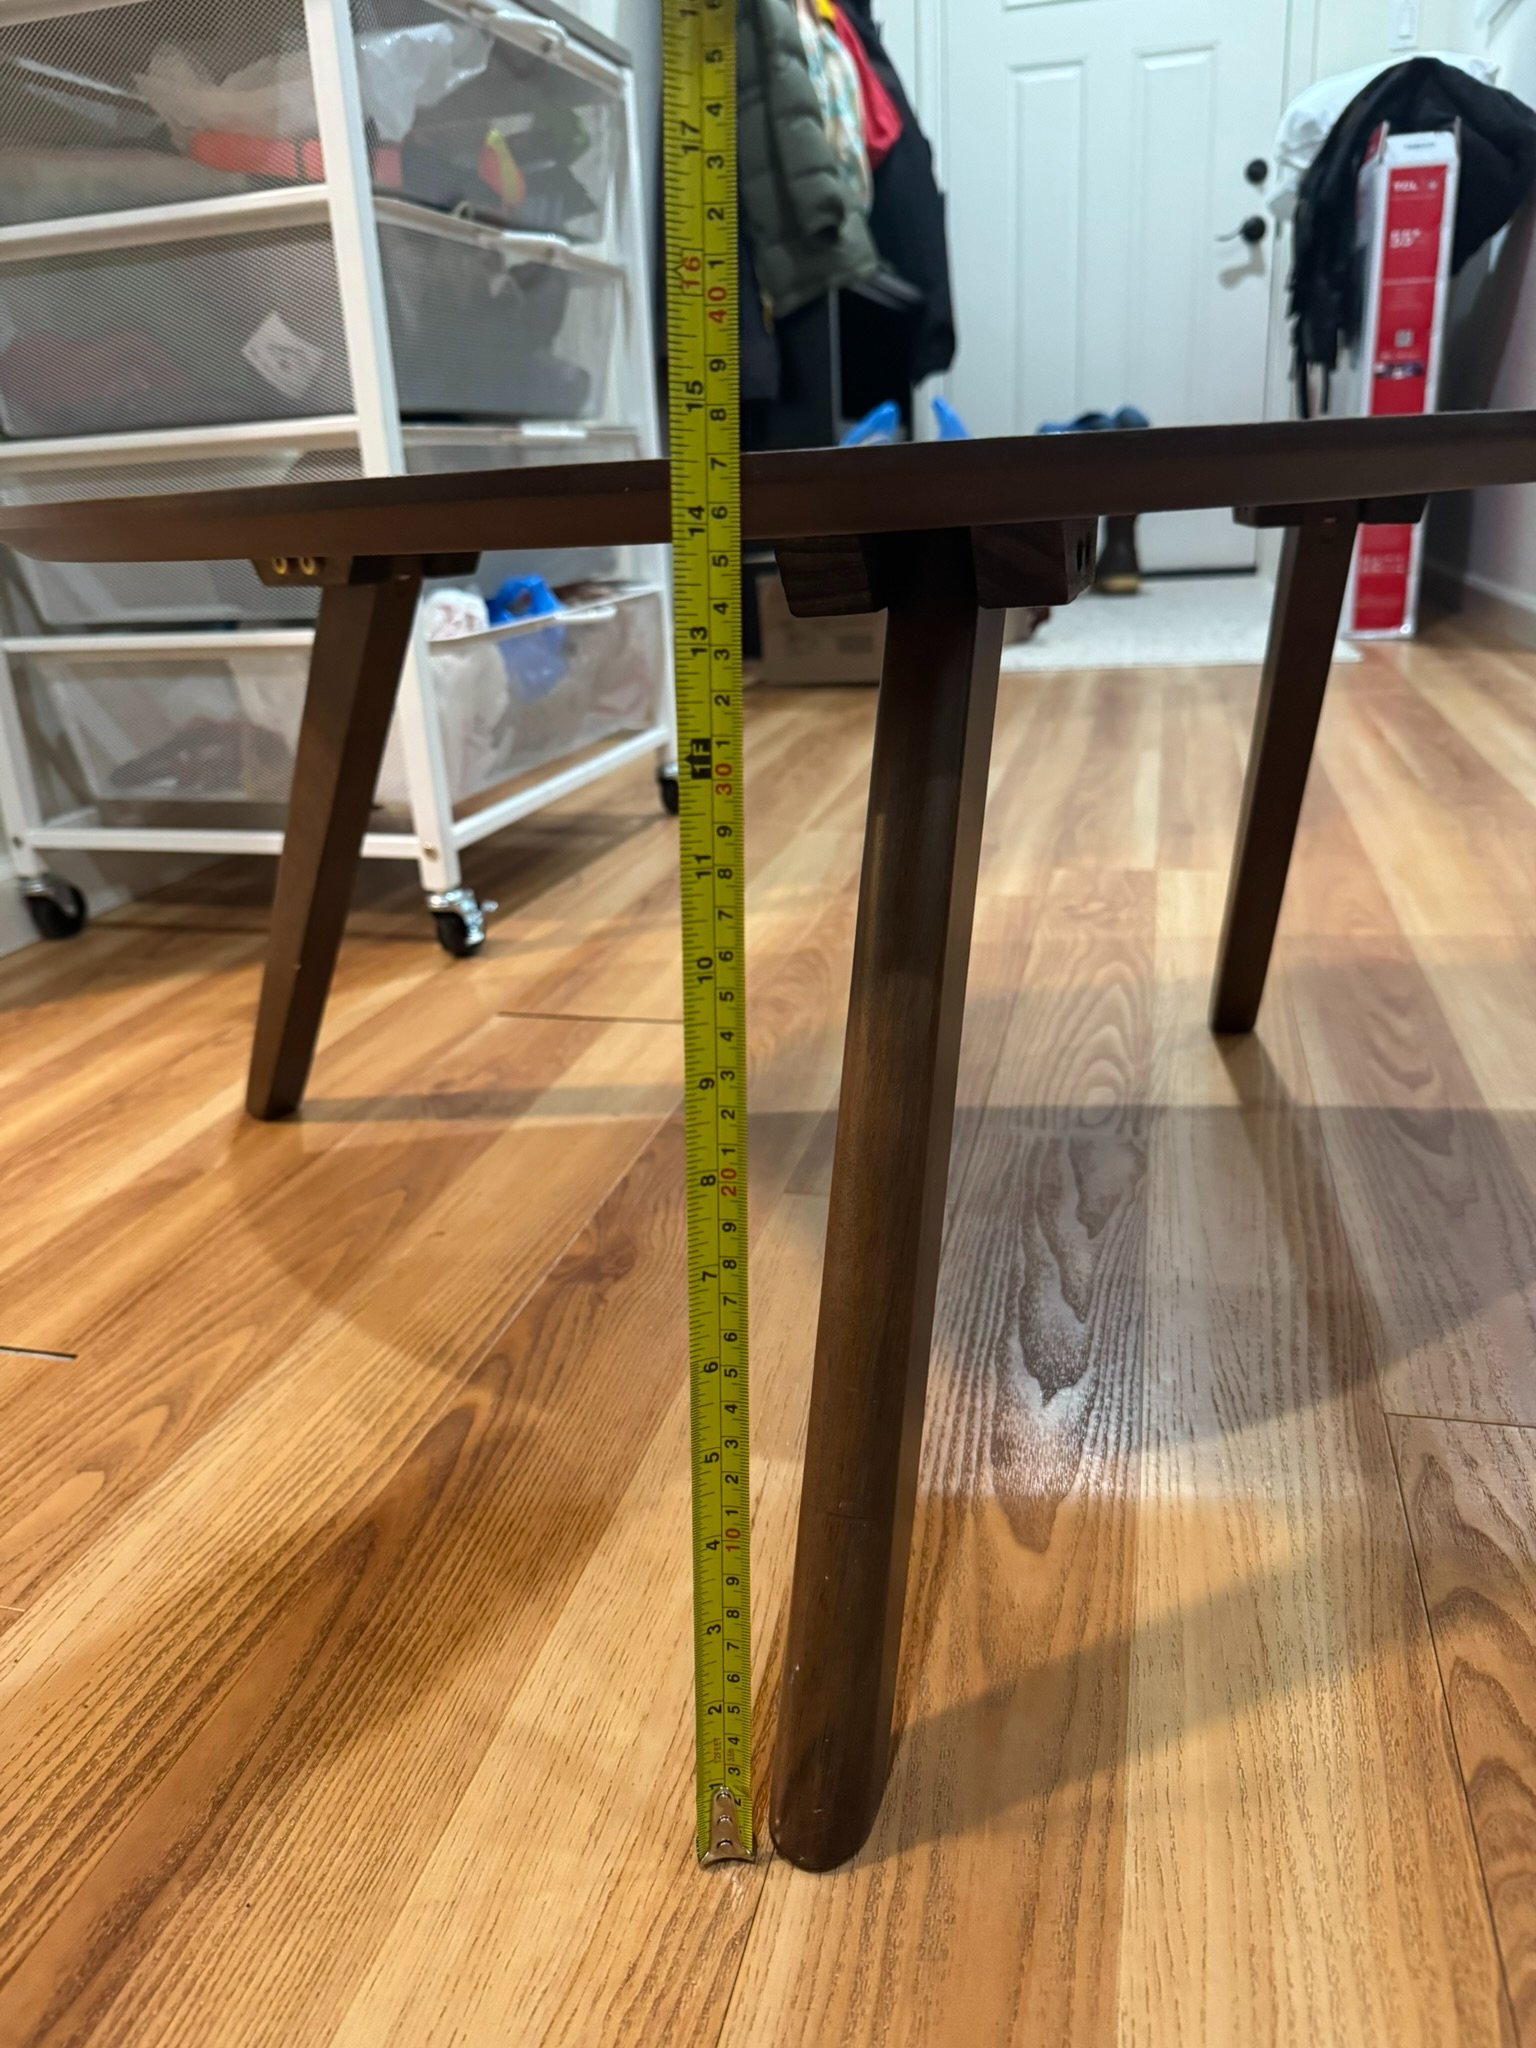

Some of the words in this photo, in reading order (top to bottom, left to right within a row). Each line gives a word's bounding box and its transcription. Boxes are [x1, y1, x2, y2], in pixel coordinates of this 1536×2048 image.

[704, 49, 723, 64] 5
[705, 102, 723, 118] 4
[679, 119, 701, 156] 17
[705, 154, 725, 170] 3
[706, 207, 725, 221] 2
[707, 259, 725, 269] 1
[680, 256, 702, 289] 16
[707, 286, 727, 324] 40
[709, 358, 727, 373] 9
[685, 379, 705, 413] 15
[709, 407, 727, 422] 8
[709, 457, 728, 471] 7
[711, 505, 729, 520] 6
[687, 505, 705, 537] 14
[712, 554, 729, 568] 5
[713, 602, 729, 615] 4
[689, 625, 708, 658] 13
[713, 649, 731, 662] 3
[714, 694, 731, 707] 2
[715, 739, 731, 749] 1
[715, 763, 733, 797] 30
[716, 825, 733, 838] 9
[694, 854, 712, 880] 11
[717, 867, 733, 881] 8
[718, 909, 734, 922] 7
[718, 950, 734, 963] 6
[696, 956, 713, 985] 10
[719, 991, 735, 1003] 5
[719, 1031, 735, 1042] 4
[720, 1069, 736, 1082] 3
[698, 1077, 716, 1091] 9
[720, 1108, 736, 1121] 2
[721, 1146, 736, 1156] 1
[700, 1173, 717, 1188] 8
[720, 1167, 737, 1197] 20
[721, 1221, 737, 1233] 9
[721, 1259, 737, 1271] 8
[701, 1270, 718, 1283] 7
[723, 1295, 737, 1307] 7
[723, 1331, 738, 1343] 6
[703, 1361, 719, 1375] 6
[723, 1367, 739, 1379] 5
[723, 1403, 739, 1415] 4
[724, 1439, 739, 1449] 3
[703, 1451, 720, 1465] 5
[724, 1473, 739, 1485] 2
[725, 1508, 739, 1517] 1
[705, 1539, 721, 1551] 4
[724, 1527, 741, 1553] 10
[725, 1575, 740, 1587] 9
[725, 1609, 741, 1620] 8
[706, 1623, 722, 1636] 3
[726, 1641, 741, 1651] 7
[726, 1673, 741, 1684] 6
[707, 1703, 722, 1717] 2
[727, 1704, 741, 1715] 5
[727, 1736, 741, 1746] 4
[727, 1766, 741, 1777] 3
